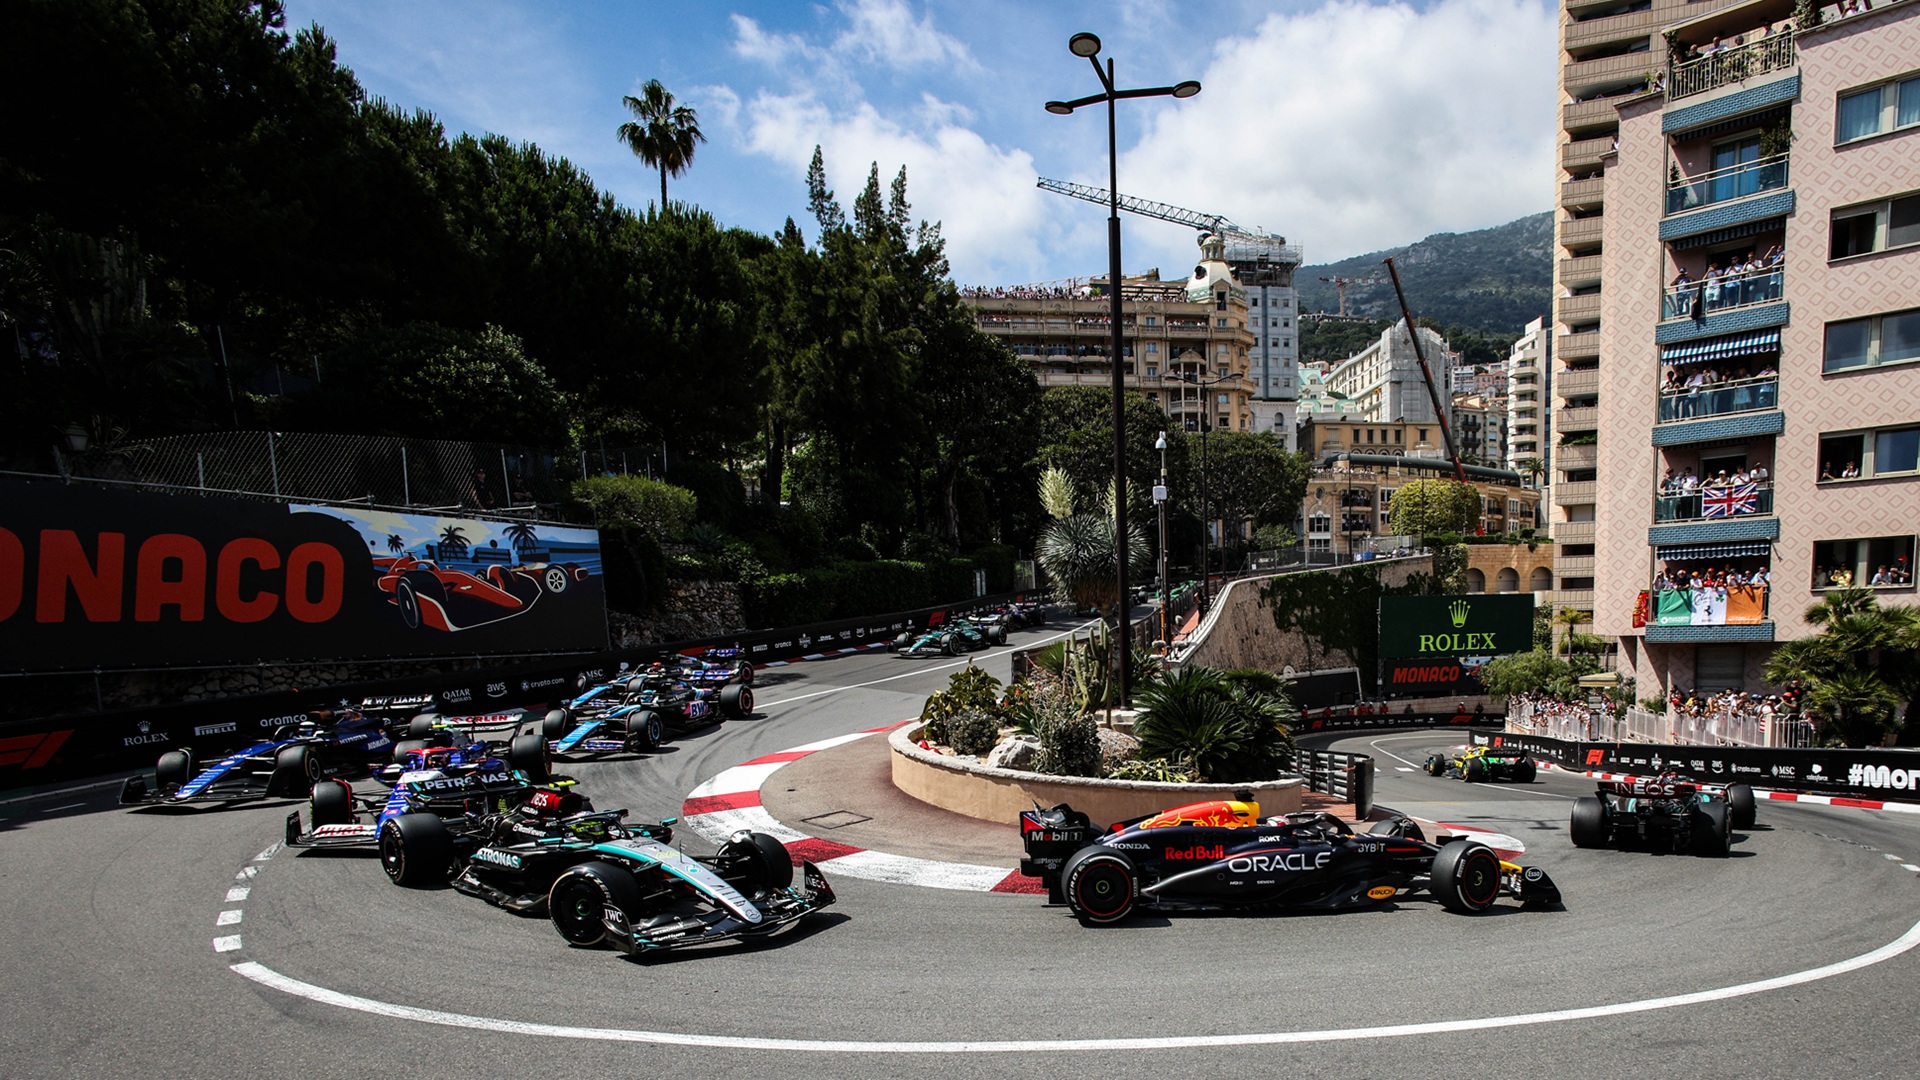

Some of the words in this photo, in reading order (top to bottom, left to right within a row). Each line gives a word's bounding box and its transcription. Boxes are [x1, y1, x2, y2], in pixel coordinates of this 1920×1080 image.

[1418, 633, 1497, 652] ROLEX
[585, 669, 604, 679] MSC
[1392, 665, 1460, 683] MONACO
[487, 682, 506, 692] aws
[530, 678, 564, 688] crypto.com
[443, 689, 470, 700] QATAR
[260, 714, 308, 727] aramco
[194, 722, 237, 736] PIRELLI
[123, 732, 169, 746] ROLEX
[1779, 766, 1795, 775] MSC
[1614, 782, 1675, 796] INEOS
[1031, 831, 1068, 841] Mobil
[1258, 835, 1280, 843] ROKT
[1165, 847, 1194, 860] Red
[1195, 845, 1225, 859] Bull
[1358, 842, 1386, 853] BYBIT
[1228, 852, 1331, 873] ORACLE
[805, 876, 826, 889] INEOS
[604, 908, 623, 923] IWC
